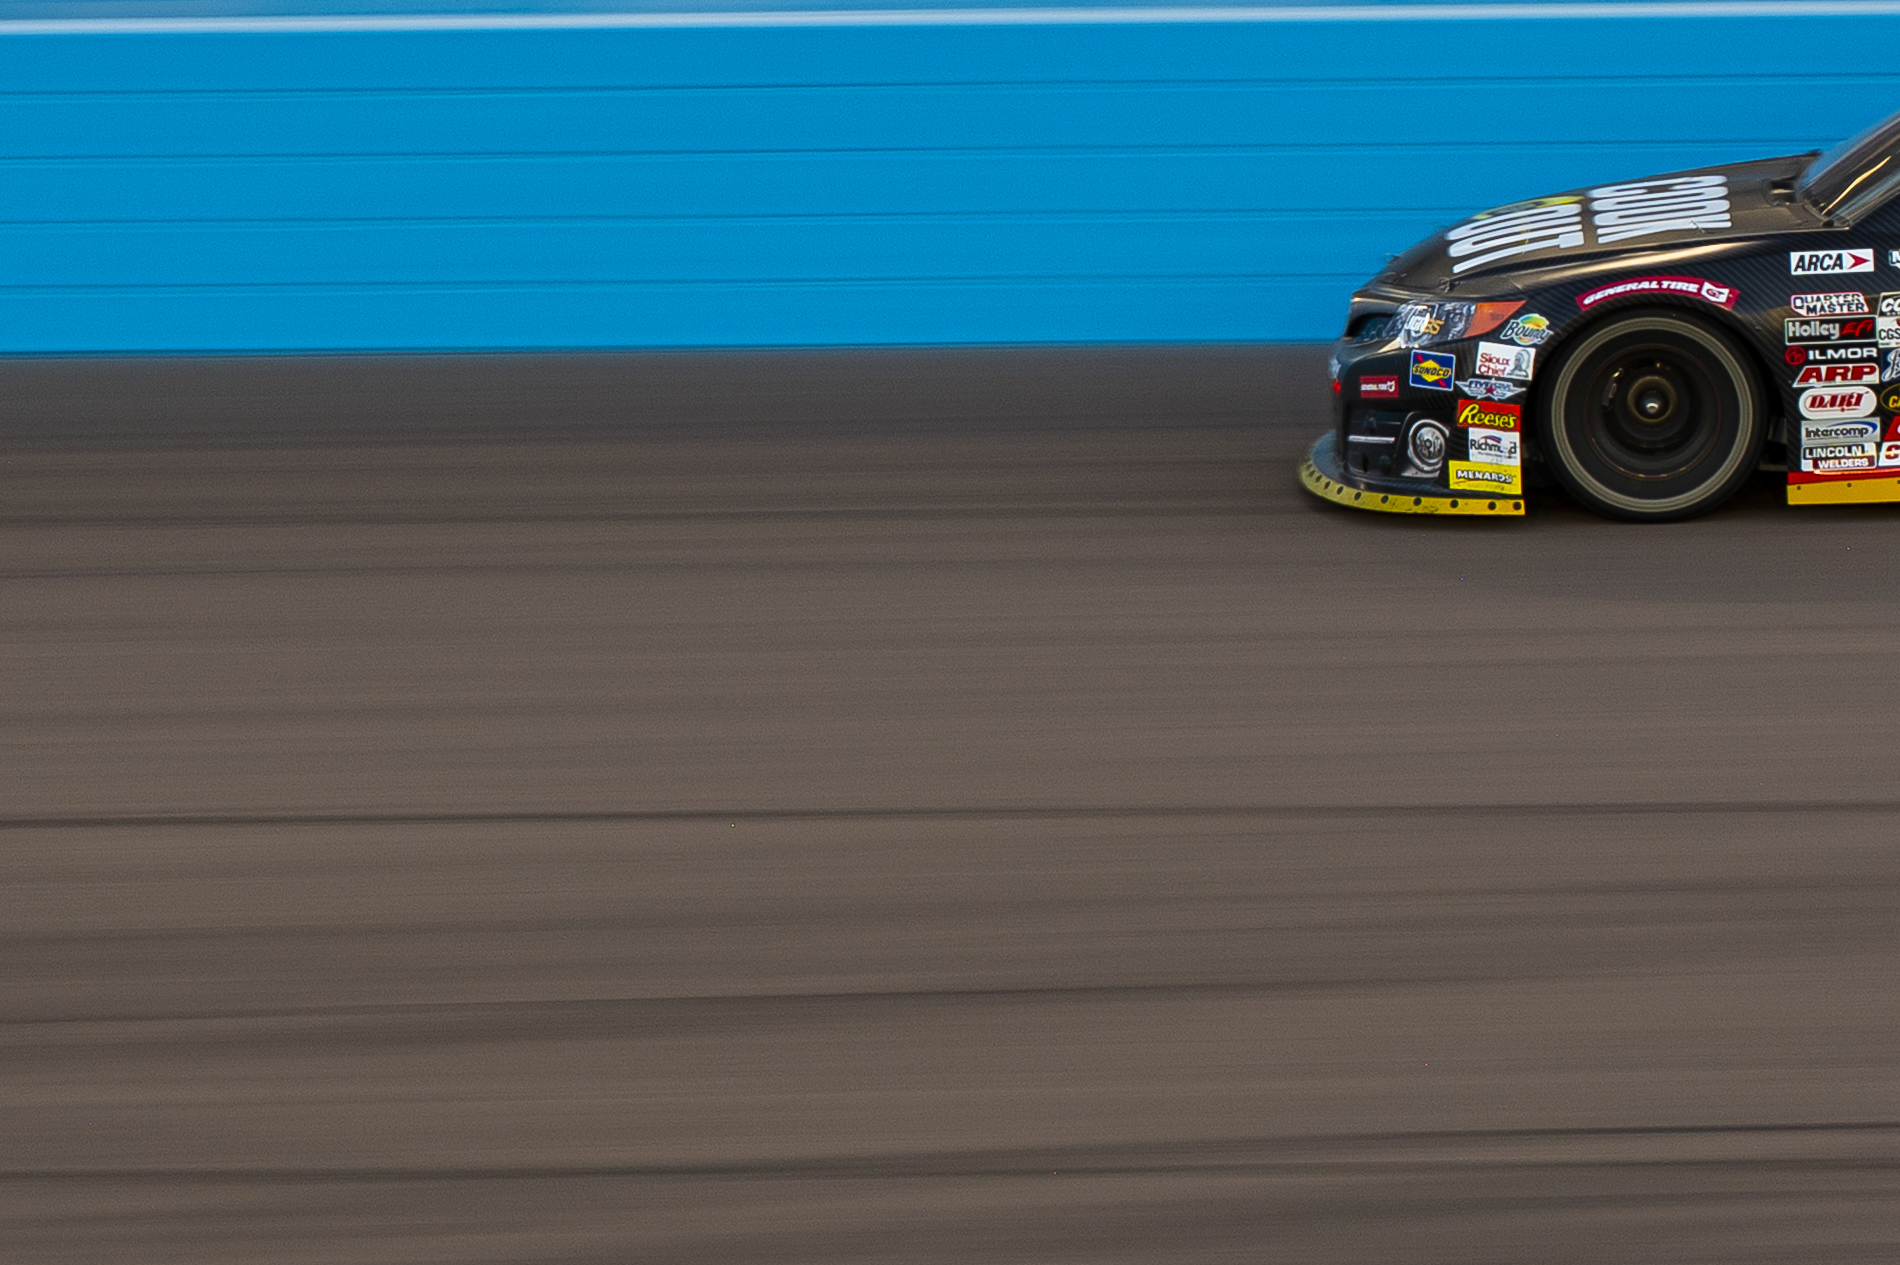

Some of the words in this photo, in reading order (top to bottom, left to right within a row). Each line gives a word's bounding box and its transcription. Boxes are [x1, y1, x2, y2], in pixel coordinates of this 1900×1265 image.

[1588, 175, 1732, 244] COOK
[1445, 203, 1585, 274] OUT
[1793, 252, 1844, 273] ARCA
[1582, 280, 1660, 305] GENERAL
[1660, 280, 1700, 293] TIRE
[1806, 302, 1866, 315] MASTER
[1788, 321, 1840, 340] Holley
[1808, 347, 1878, 360] ILMOR
[1413, 364, 1452, 378] SUNOCO
[1797, 365, 1878, 383] ARP
[1805, 427, 1869, 438] Intercomp
[1805, 445, 1863, 458] LINCOLN
[1818, 458, 1869, 469] WELDERS
[1455, 469, 1512, 484] MENARDS
